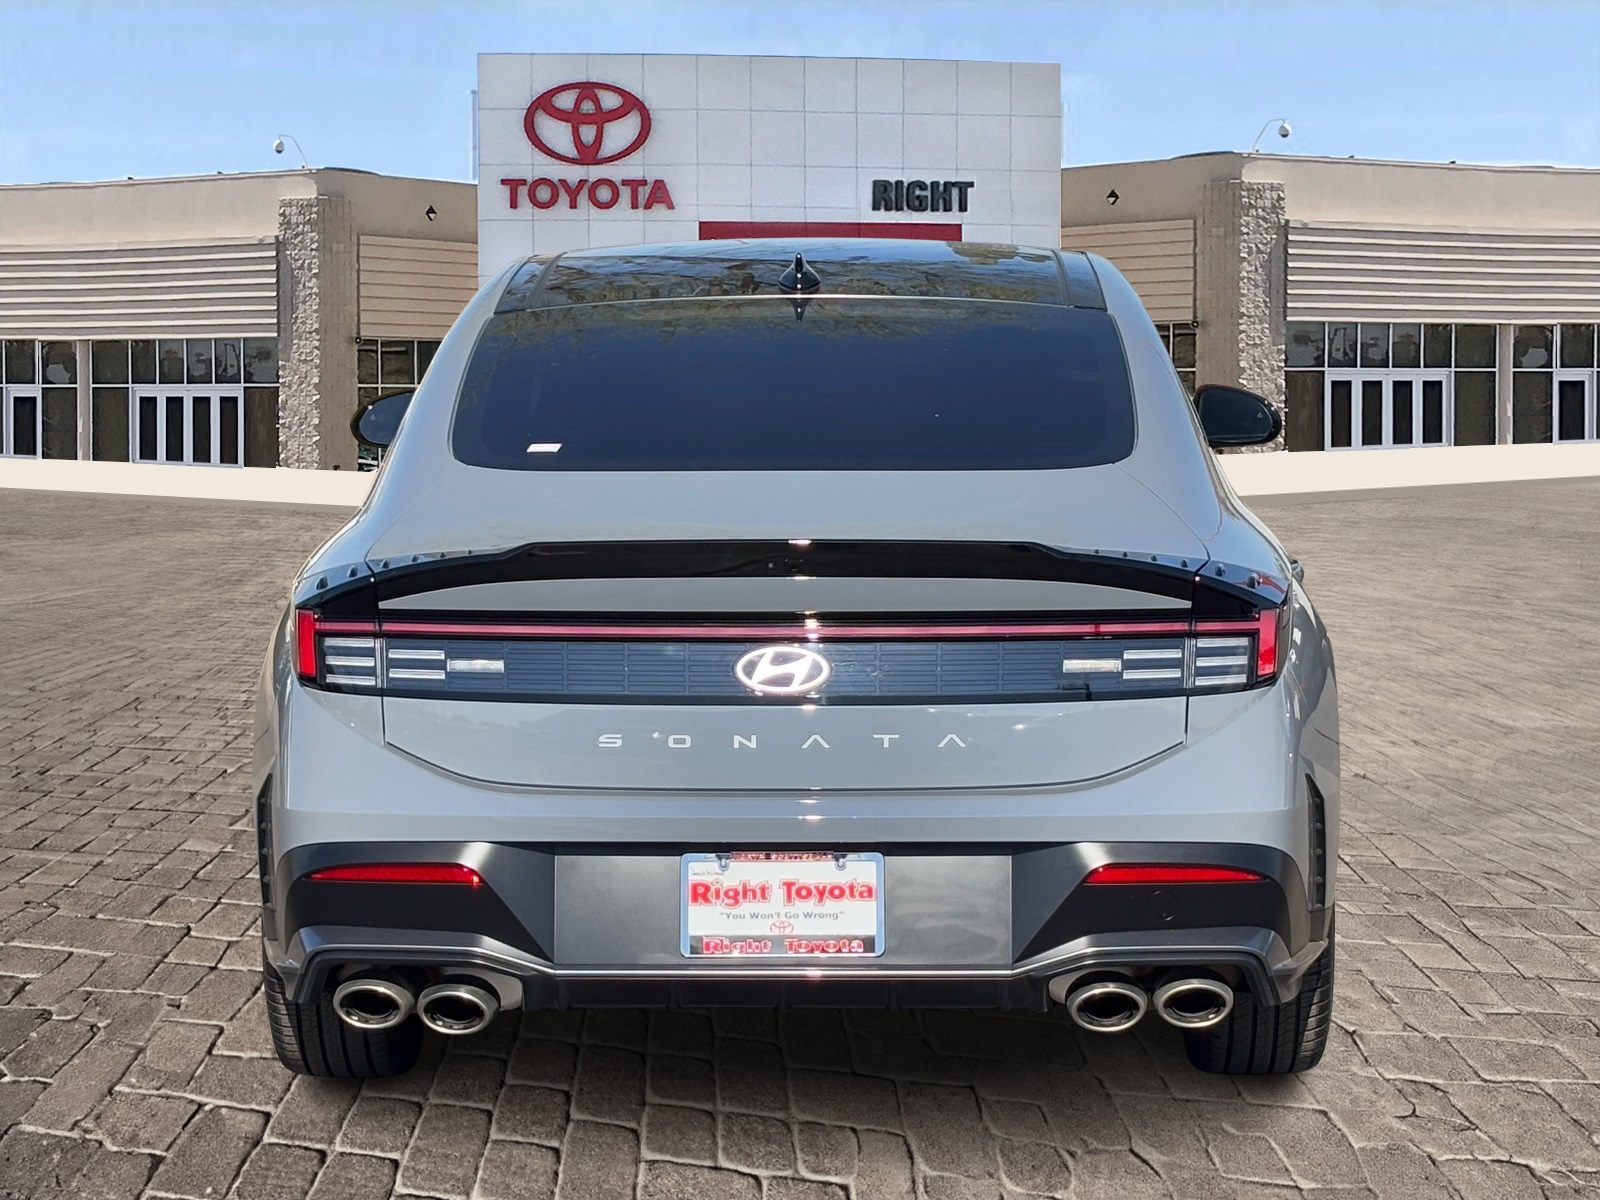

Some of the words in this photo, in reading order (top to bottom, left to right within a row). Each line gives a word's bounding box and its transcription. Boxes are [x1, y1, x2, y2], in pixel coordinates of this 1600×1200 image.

[500, 178, 676, 210] TOYOTA
[871, 179, 975, 212] RIGHT
[597, 733, 968, 749] SONATA
[689, 879, 772, 908] Right
[780, 878, 876, 906] Toyota
[749, 911, 781, 920] Won't
[784, 911, 800, 919] Go
[702, 937, 772, 954] Right
[783, 937, 864, 954] Toyota
